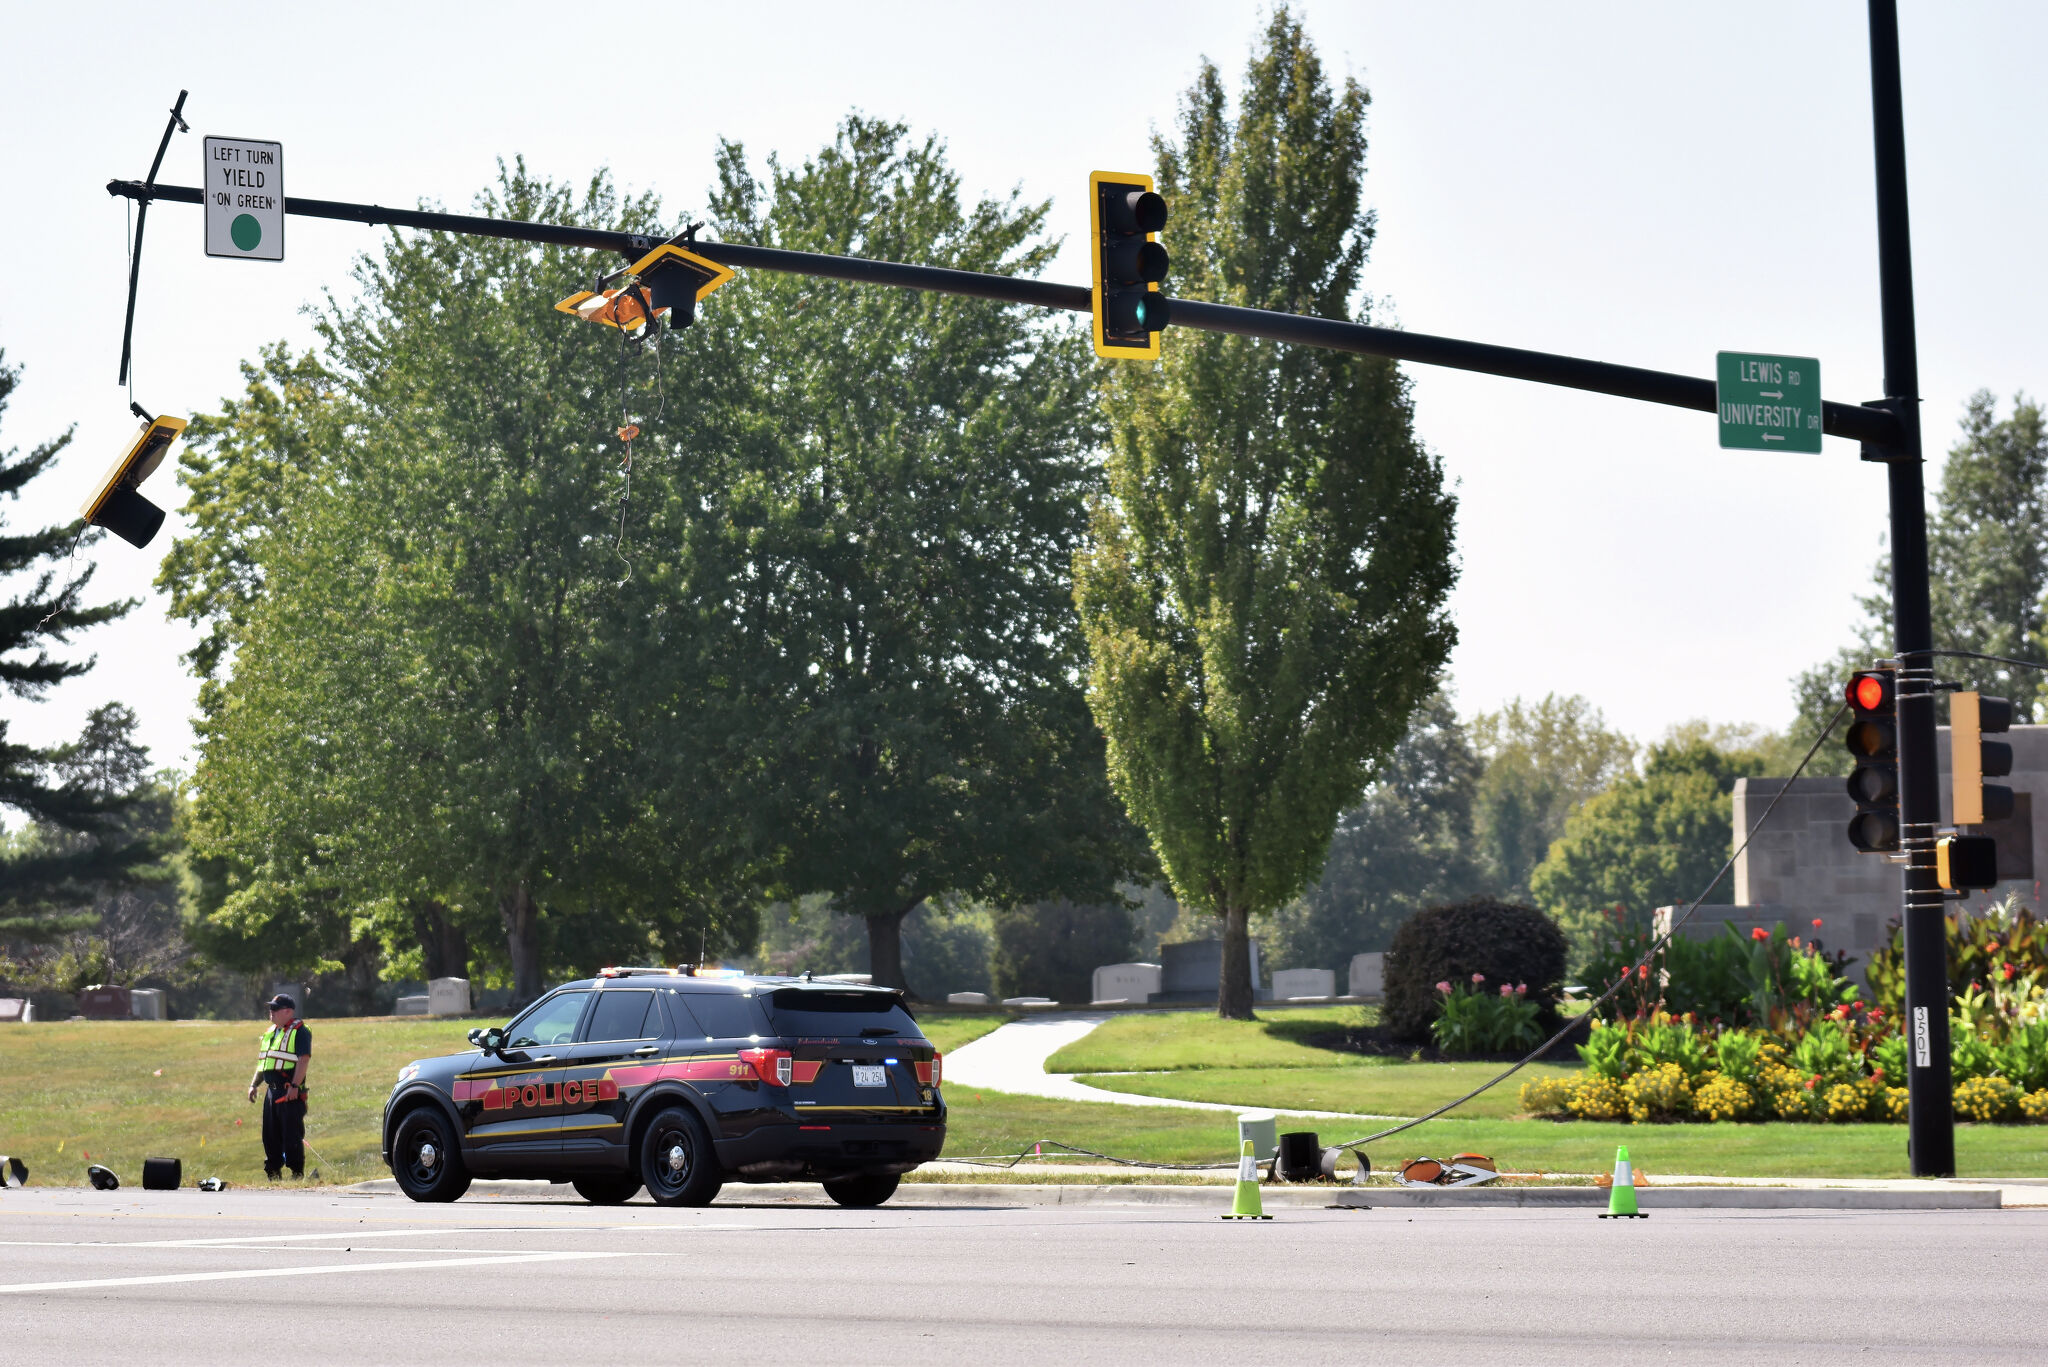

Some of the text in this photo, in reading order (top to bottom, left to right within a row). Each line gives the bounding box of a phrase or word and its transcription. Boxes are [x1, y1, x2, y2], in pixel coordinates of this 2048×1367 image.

[214, 147, 274, 165] LEFT TURN
[223, 168, 265, 188] YIELD
[217, 192, 273, 210] ON GREEN
[1740, 360, 1801, 386] LEWIS RD
[1721, 402, 1819, 430] UNIVERSITY DR
[1917, 1007, 1927, 1065] 3507
[729, 1064, 749, 1076] 911
[860, 1071, 869, 1082] 24
[872, 1071, 884, 1083] 254
[504, 1079, 599, 1110] POLICE
[922, 1089, 933, 1101] 18
